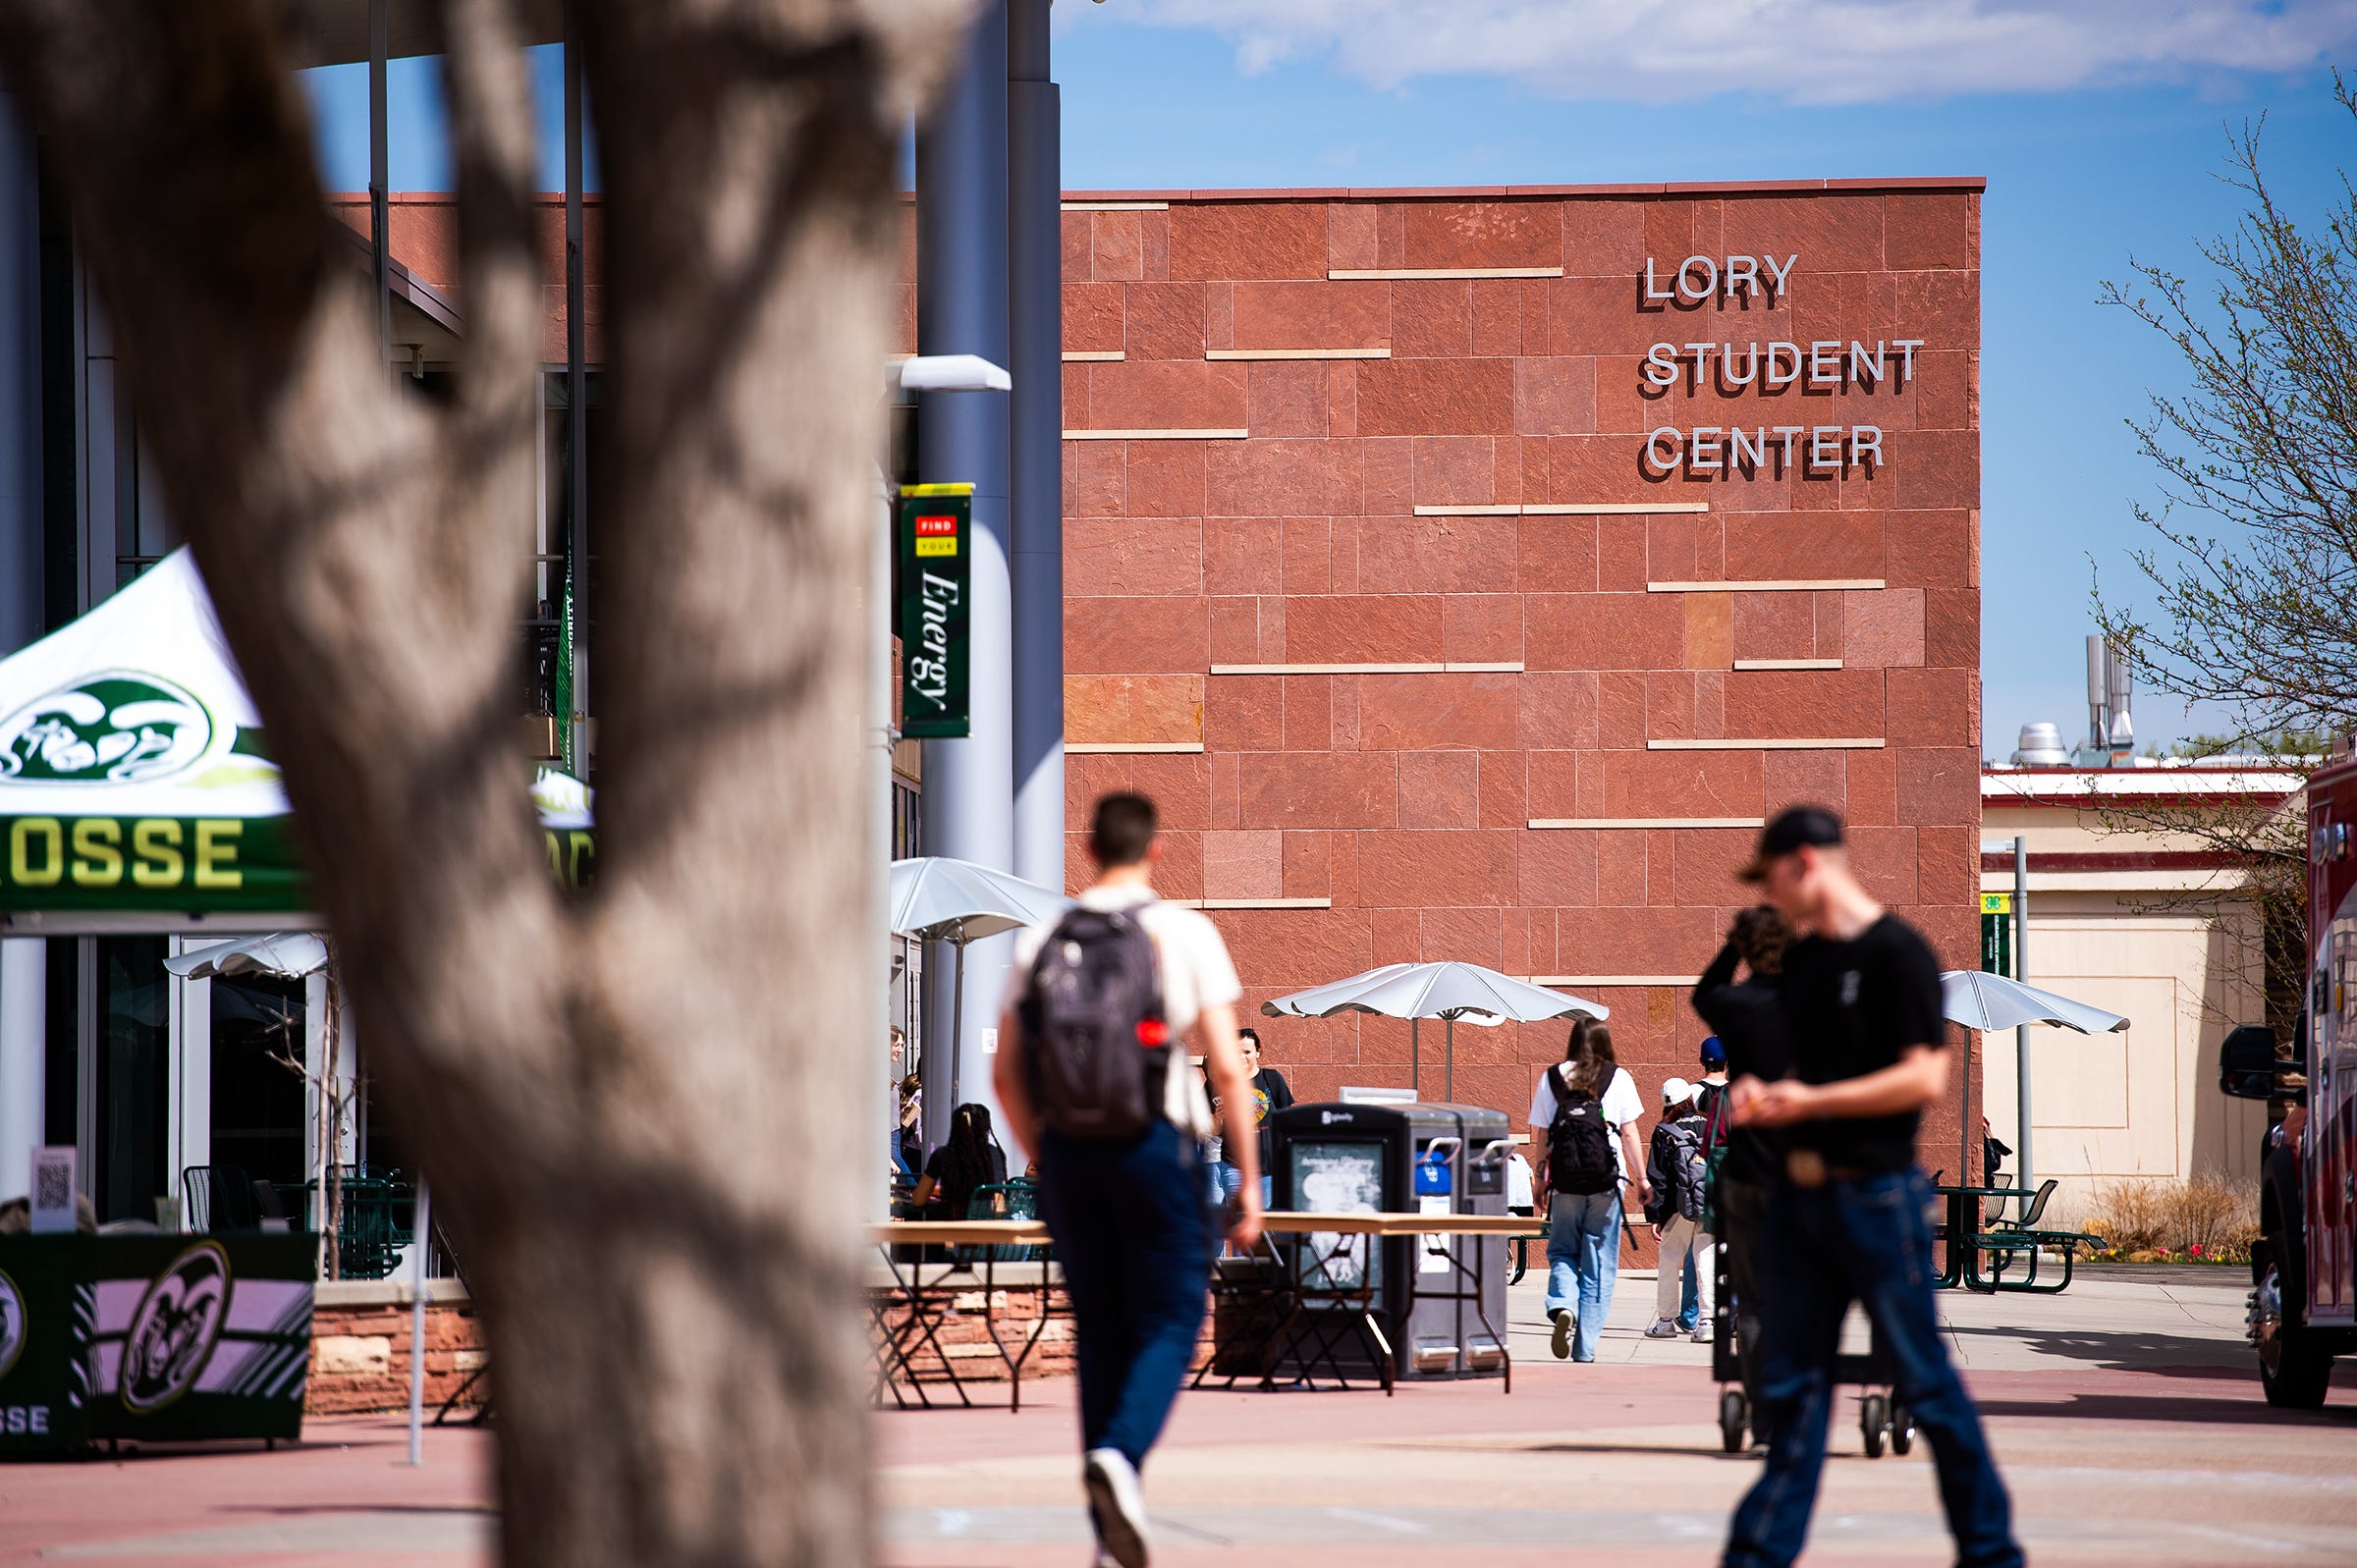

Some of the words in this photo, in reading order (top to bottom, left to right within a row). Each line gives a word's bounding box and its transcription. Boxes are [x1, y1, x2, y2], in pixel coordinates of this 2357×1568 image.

[1646, 253, 1798, 298] LORY
[1646, 340, 1925, 386] STUDENT
[1646, 425, 1885, 469] CENTER
[920, 520, 952, 532] FIND
[921, 542, 953, 551] YOUR
[910, 568, 959, 711] Energy
[9, 817, 245, 887] OSSE
